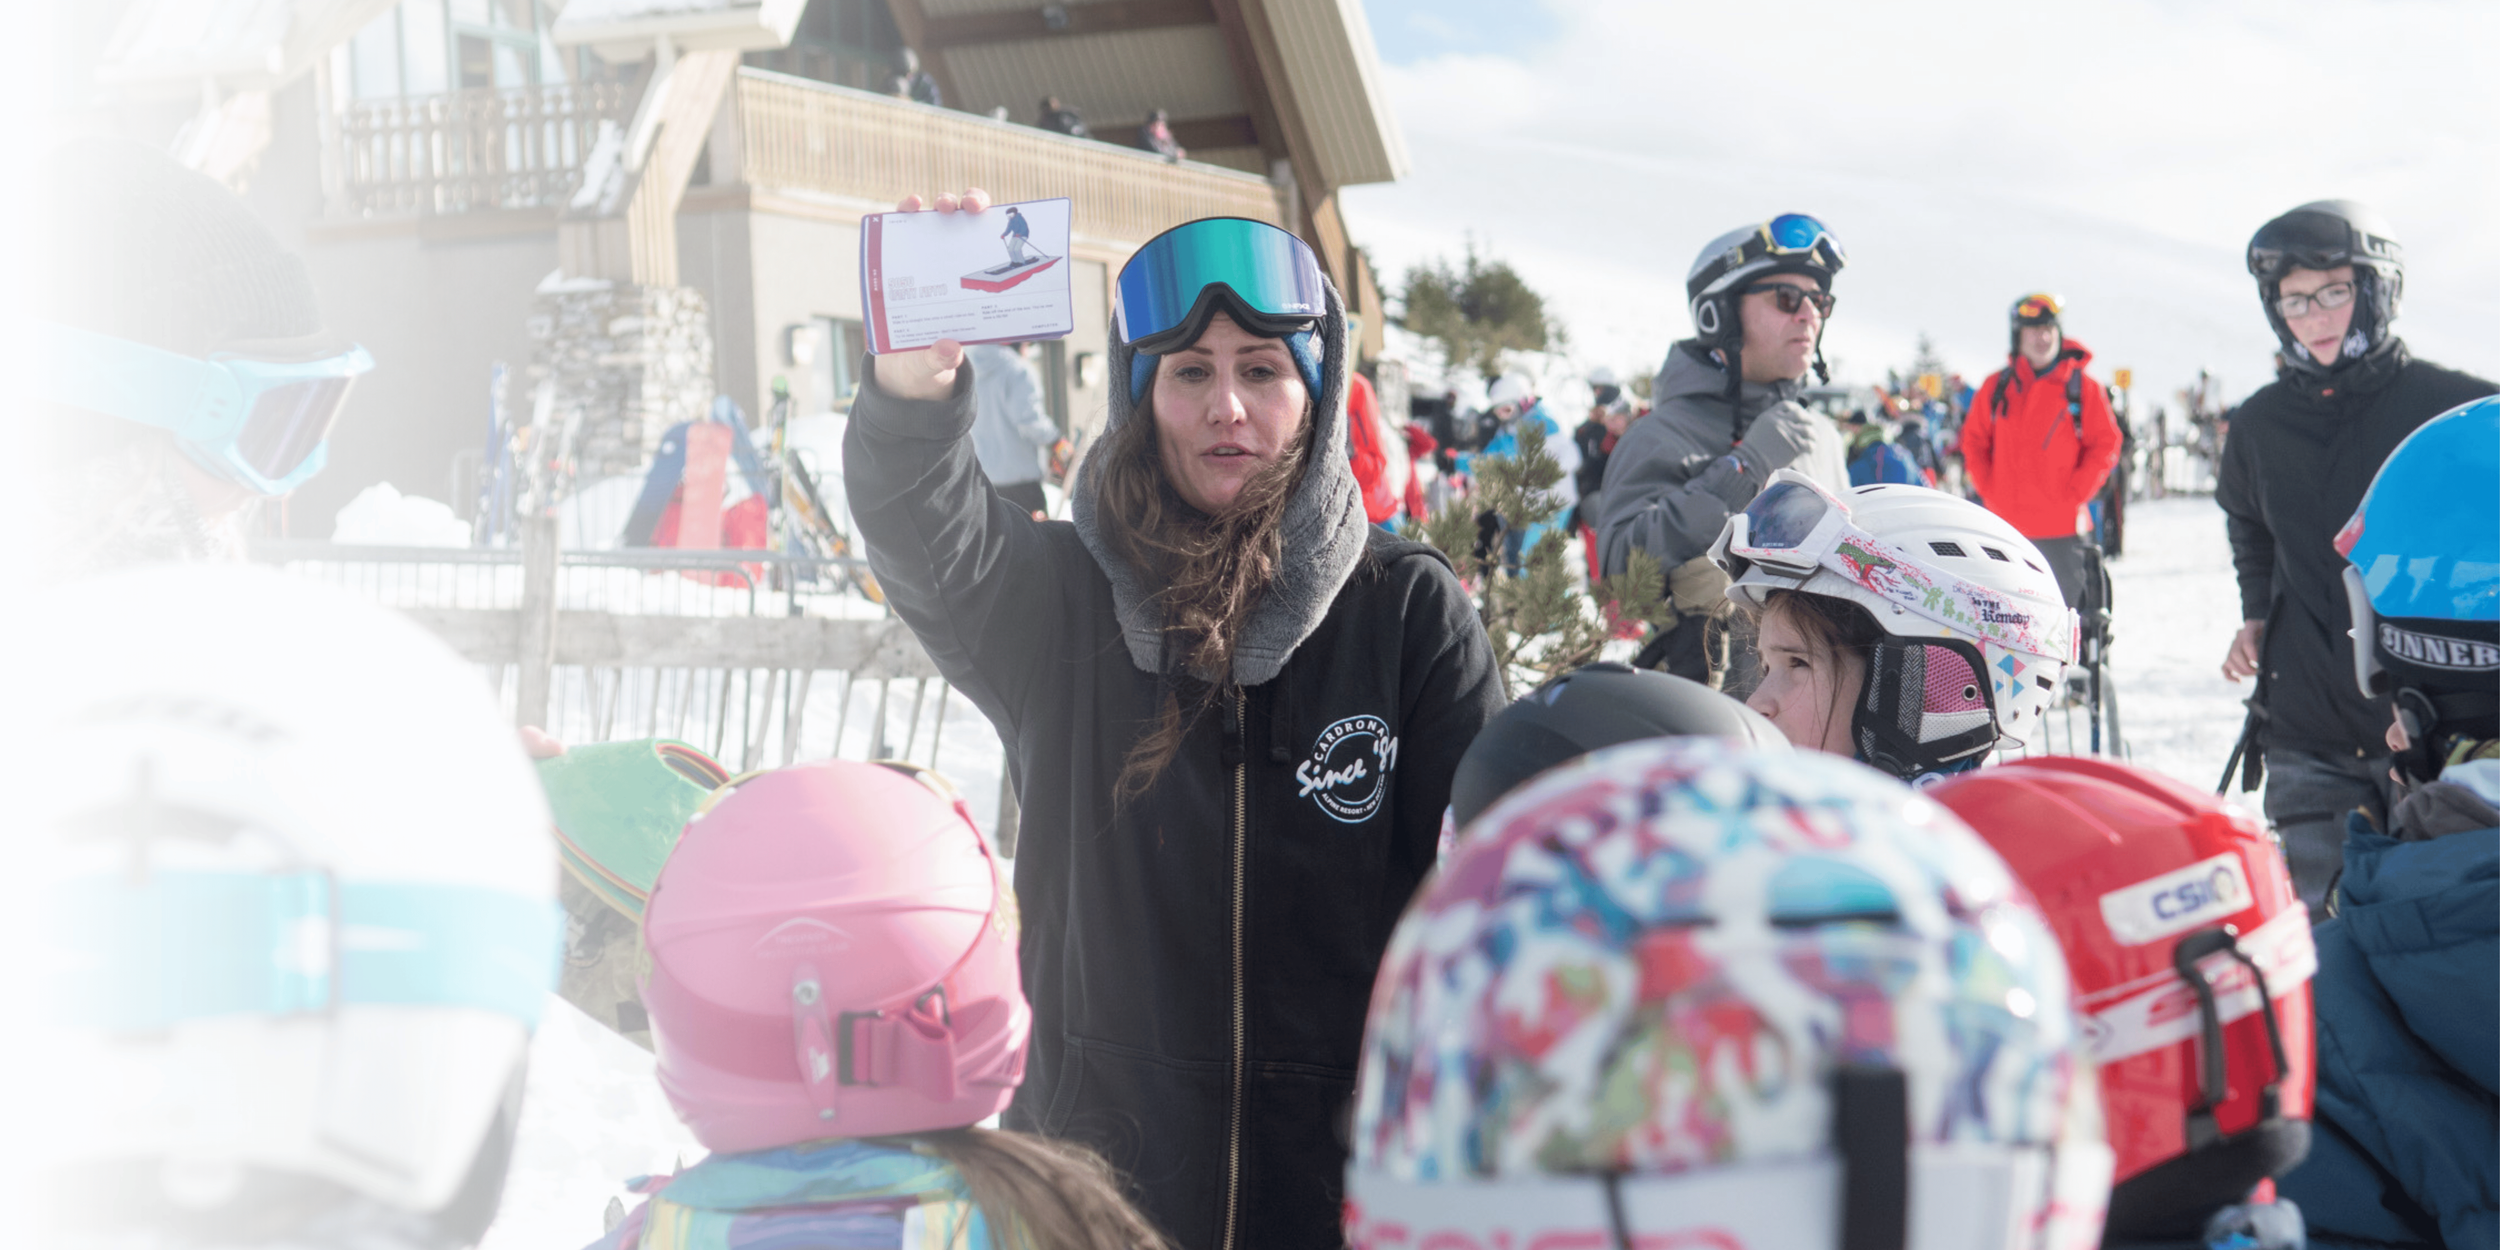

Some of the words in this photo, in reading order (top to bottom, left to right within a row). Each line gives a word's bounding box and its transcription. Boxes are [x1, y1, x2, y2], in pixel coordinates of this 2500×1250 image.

[1981, 608, 2029, 627] Remedy
[2382, 627, 2500, 666] SINNER
[1314, 720, 1386, 762] CARDRONA
[1296, 758, 1367, 797] Since
[1321, 793, 1340, 811] ALPINE
[1340, 806, 1364, 815] RESORT
